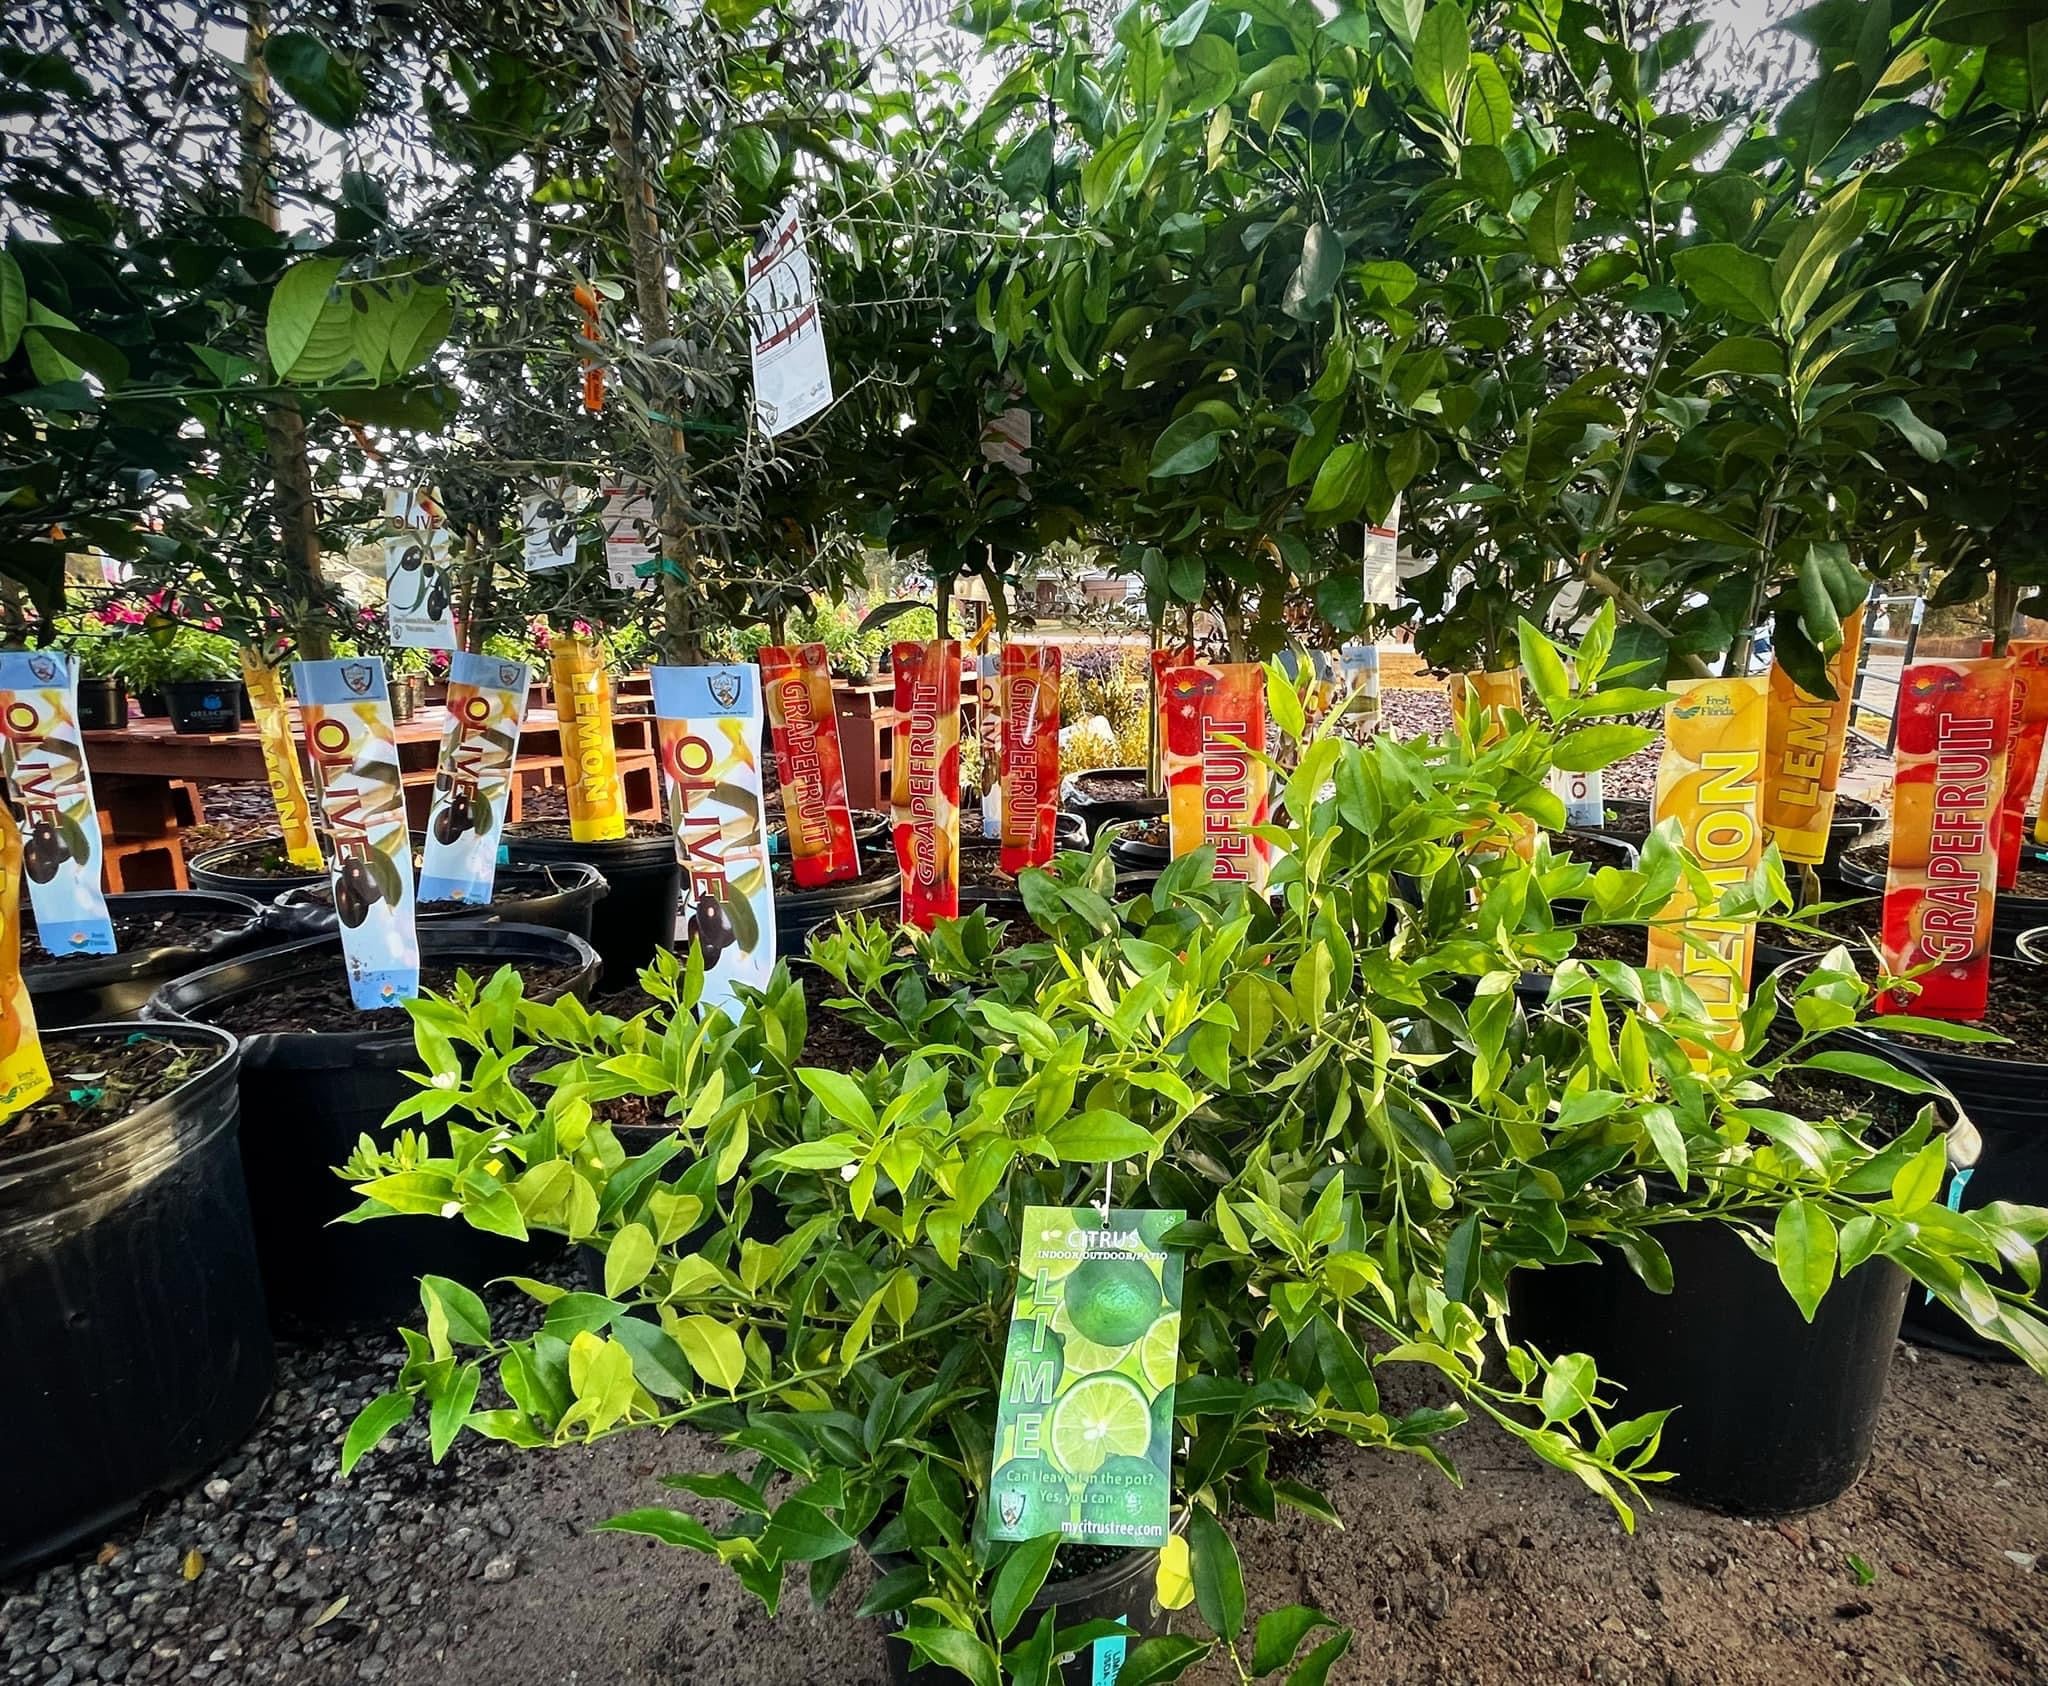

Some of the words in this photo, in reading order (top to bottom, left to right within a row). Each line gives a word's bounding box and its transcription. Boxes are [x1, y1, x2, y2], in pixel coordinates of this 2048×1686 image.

[393, 515, 441, 529] OLIVE
[6, 702, 64, 829] OLIVE
[313, 718, 374, 865] OLIVE
[452, 696, 491, 802] OLIVE
[571, 673, 609, 802] LEMON
[781, 679, 831, 845] GRAPEFRUIT
[908, 680, 938, 886] GRAPEFRUIT
[1009, 678, 1041, 841] GRAPEFRUIT
[674, 735, 729, 903] OLIVE
[1921, 713, 1994, 962] GRAPEFRUIT
[1067, 1230, 1139, 1249] CITRUS
[1009, 1267, 1059, 1459] LIME
[1006, 1470, 1029, 1482] Can
[1032, 1471, 1036, 1482] I
[1039, 1471, 1071, 1483] leave
[1074, 1472, 1083, 1483] it
[1101, 1472, 1122, 1485] the
[1125, 1473, 1154, 1487] pot?
[1040, 1490, 1063, 1504] Yes,
[1065, 1494, 1088, 1505] you
[1091, 1494, 1117, 1504] can.
[1061, 1520, 1162, 1537] mycitrustree.com
